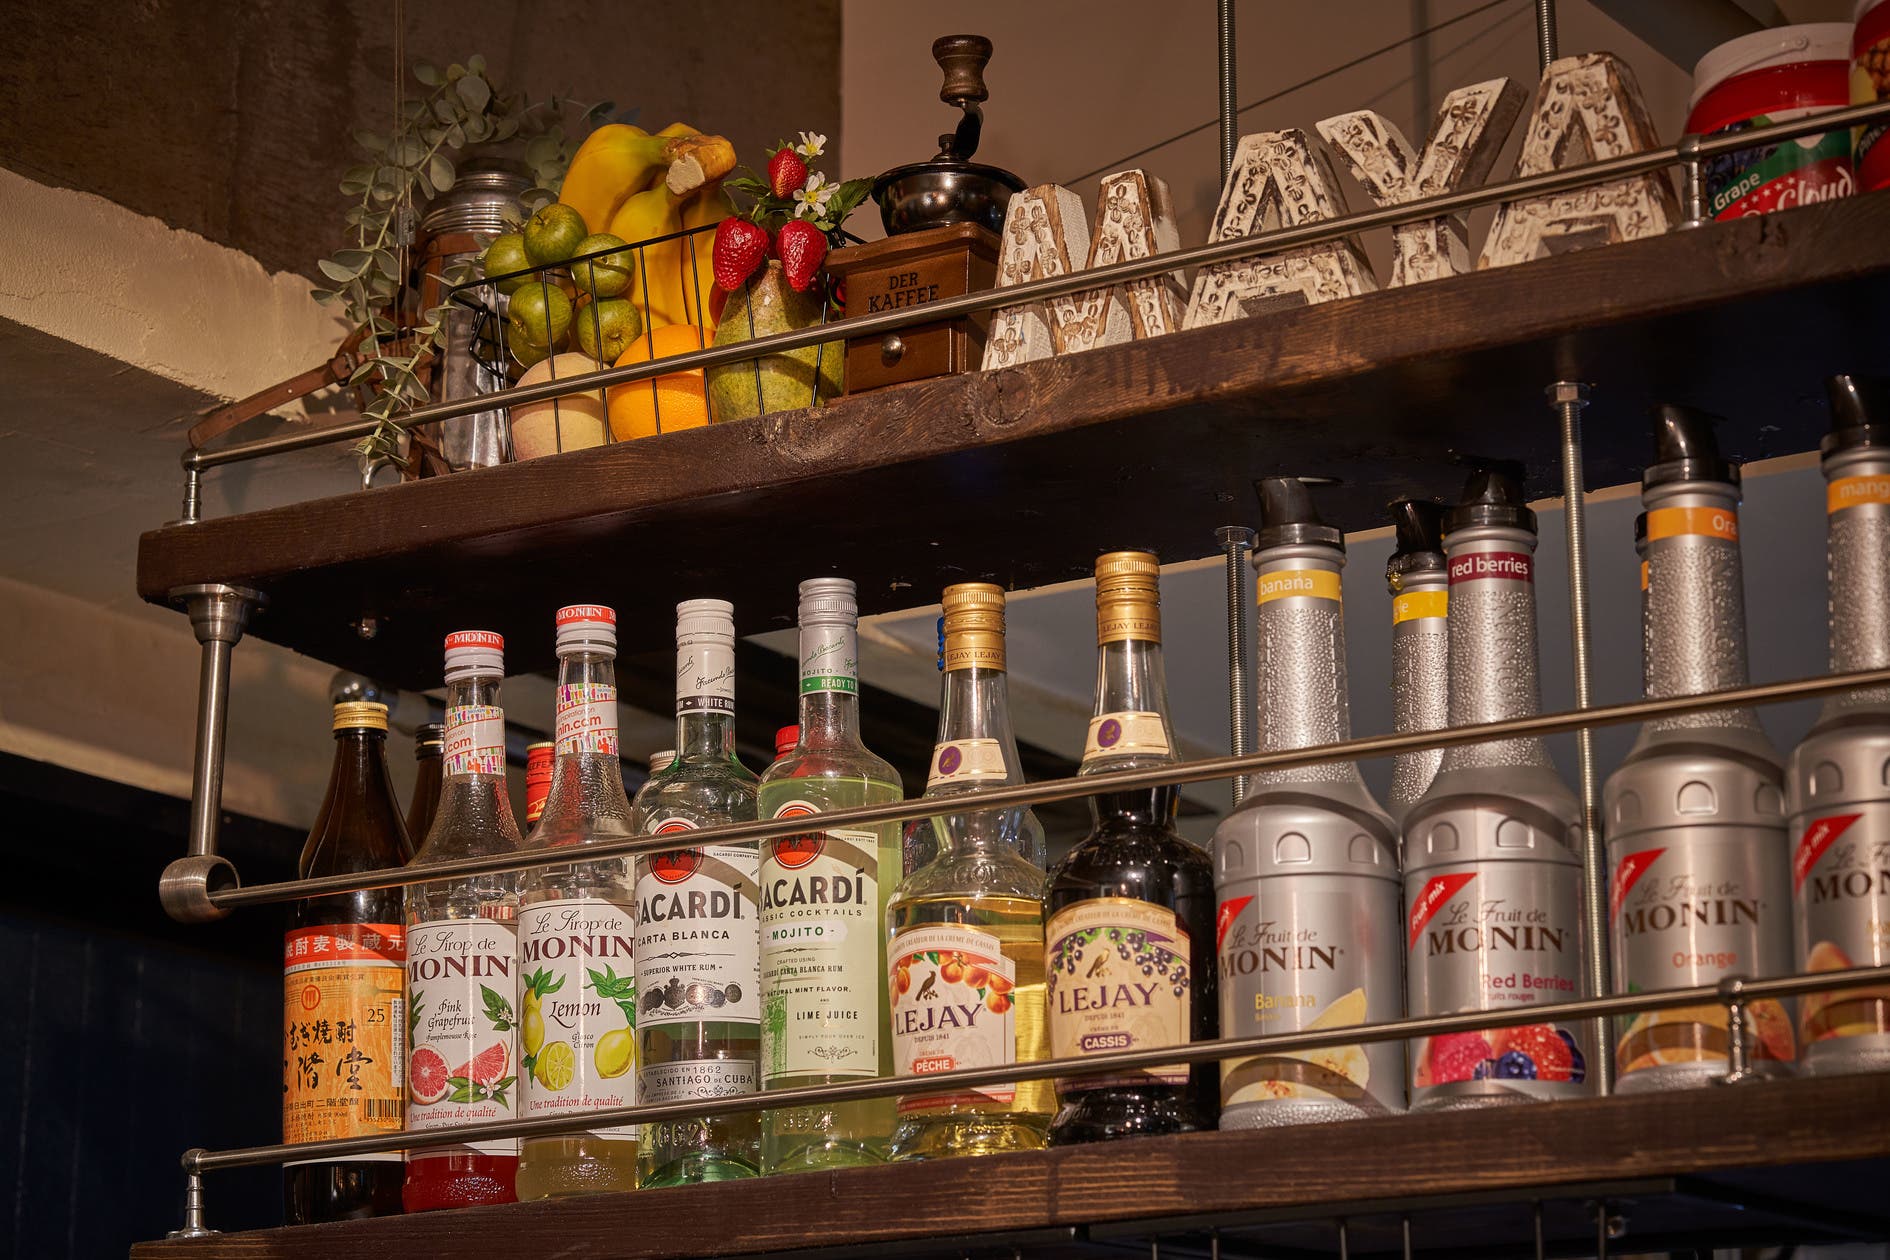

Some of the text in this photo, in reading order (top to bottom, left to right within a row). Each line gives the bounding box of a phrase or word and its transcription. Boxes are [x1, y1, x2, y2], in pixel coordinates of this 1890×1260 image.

[1714, 172, 1760, 211] Grape
[889, 272, 918, 290] DER
[867, 284, 940, 313] KAFFEE
[1713, 514, 1737, 536] Ora
[1452, 557, 1529, 578] red berries
[1260, 577, 1313, 595] banana
[557, 608, 602, 619] MONIN
[974, 650, 1002, 661] LEJAY
[821, 679, 846, 689] READY
[698, 698, 723, 708] WHITE
[558, 716, 602, 737] nin.com
[446, 737, 472, 755] .com
[760, 867, 865, 913] ACARDÍ
[1428, 880, 1446, 905] mix
[1716, 882, 1739, 895] de
[790, 909, 862, 918] COCKTAILS
[1442, 899, 1547, 926] Le Fruit de
[1625, 899, 1759, 938] MONIN
[530, 910, 622, 936] Le Sirop de
[638, 930, 730, 947] CARTA BLANCA
[772, 926, 824, 940] MOJITO
[1227, 924, 1248, 951] Le
[1247, 921, 1292, 946] Fruit
[1296, 928, 1318, 942] de
[1428, 925, 1563, 957] MONIN
[411, 931, 496, 957] Le Sirop de
[522, 935, 636, 964] MONIN
[1220, 945, 1337, 981] MONIN
[1672, 951, 1738, 969] Orange
[407, 955, 511, 984] MONIN
[643, 968, 671, 977] SUPERIOR
[672, 964, 697, 973] WHITE
[799, 965, 825, 974] BLANCA
[827, 965, 843, 973] RUM
[1482, 973, 1574, 992] Red Berries
[767, 987, 793, 998] NATURAL
[1059, 982, 1159, 1014] LEJAY
[1255, 992, 1316, 1010] Banana
[367, 1008, 385, 1023] 25
[437, 998, 462, 1015] Pink
[548, 1000, 601, 1028] Lemon
[797, 1010, 859, 1020] LIME JUICE
[895, 1003, 984, 1036] LEJAY
[572, 1032, 594, 1043] Glsco
[1084, 1036, 1127, 1049] CASSIS
[693, 1065, 721, 1074] 1862
[916, 1059, 950, 1073] PÊCHE
[656, 1075, 711, 1088] SANTIAGO
[724, 1074, 753, 1084] CUBA
[421, 1108, 453, 1121] tradition
[454, 1106, 464, 1118] de
[466, 1105, 497, 1121] qualité
[530, 1099, 543, 1110] Une
[543, 1096, 580, 1109] tradition
[582, 1096, 592, 1107] de
[593, 1096, 624, 1113] qualité
